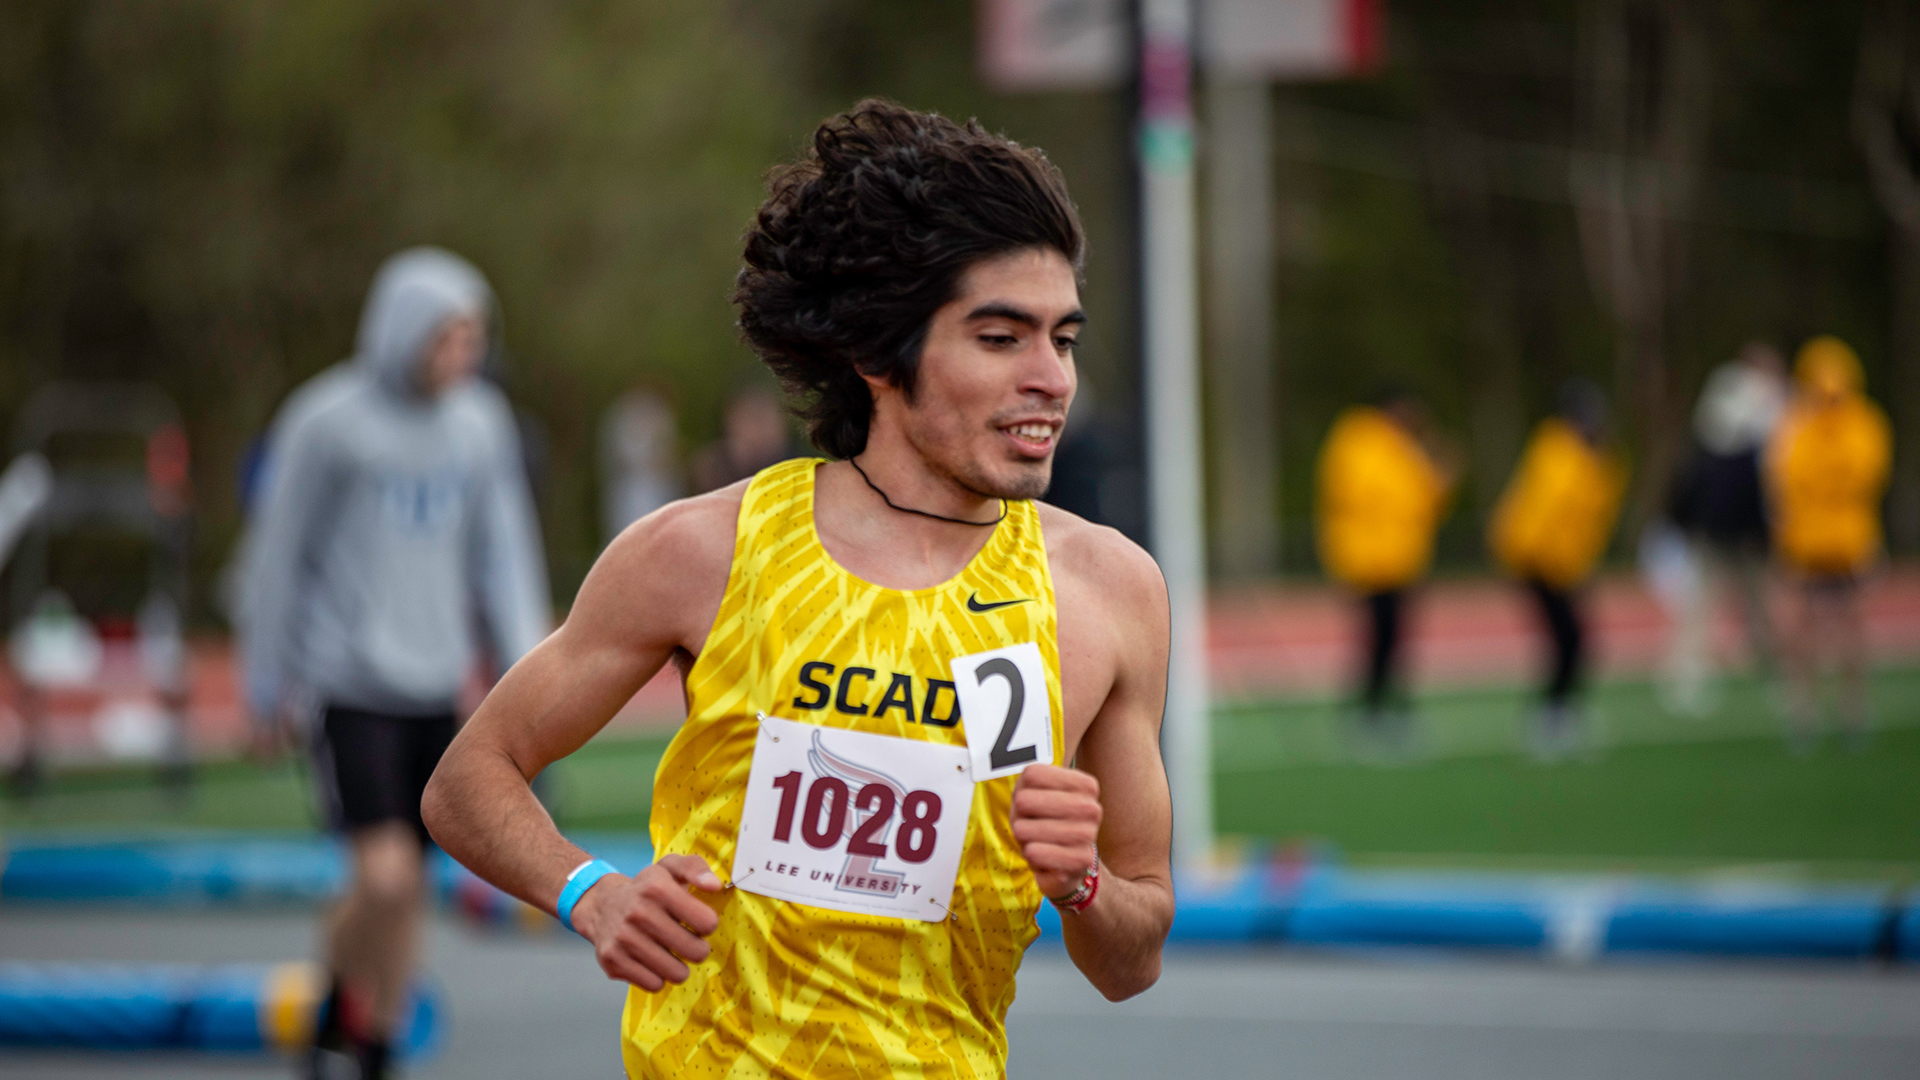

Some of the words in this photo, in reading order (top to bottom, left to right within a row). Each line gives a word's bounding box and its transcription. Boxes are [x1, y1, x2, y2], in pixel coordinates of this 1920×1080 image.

[791, 660, 962, 729] SCAD
[974, 656, 1038, 772] 2
[772, 769, 943, 865] 1028
[765, 860, 800, 877] LEE
[810, 870, 922, 896] UNIVERSITY
